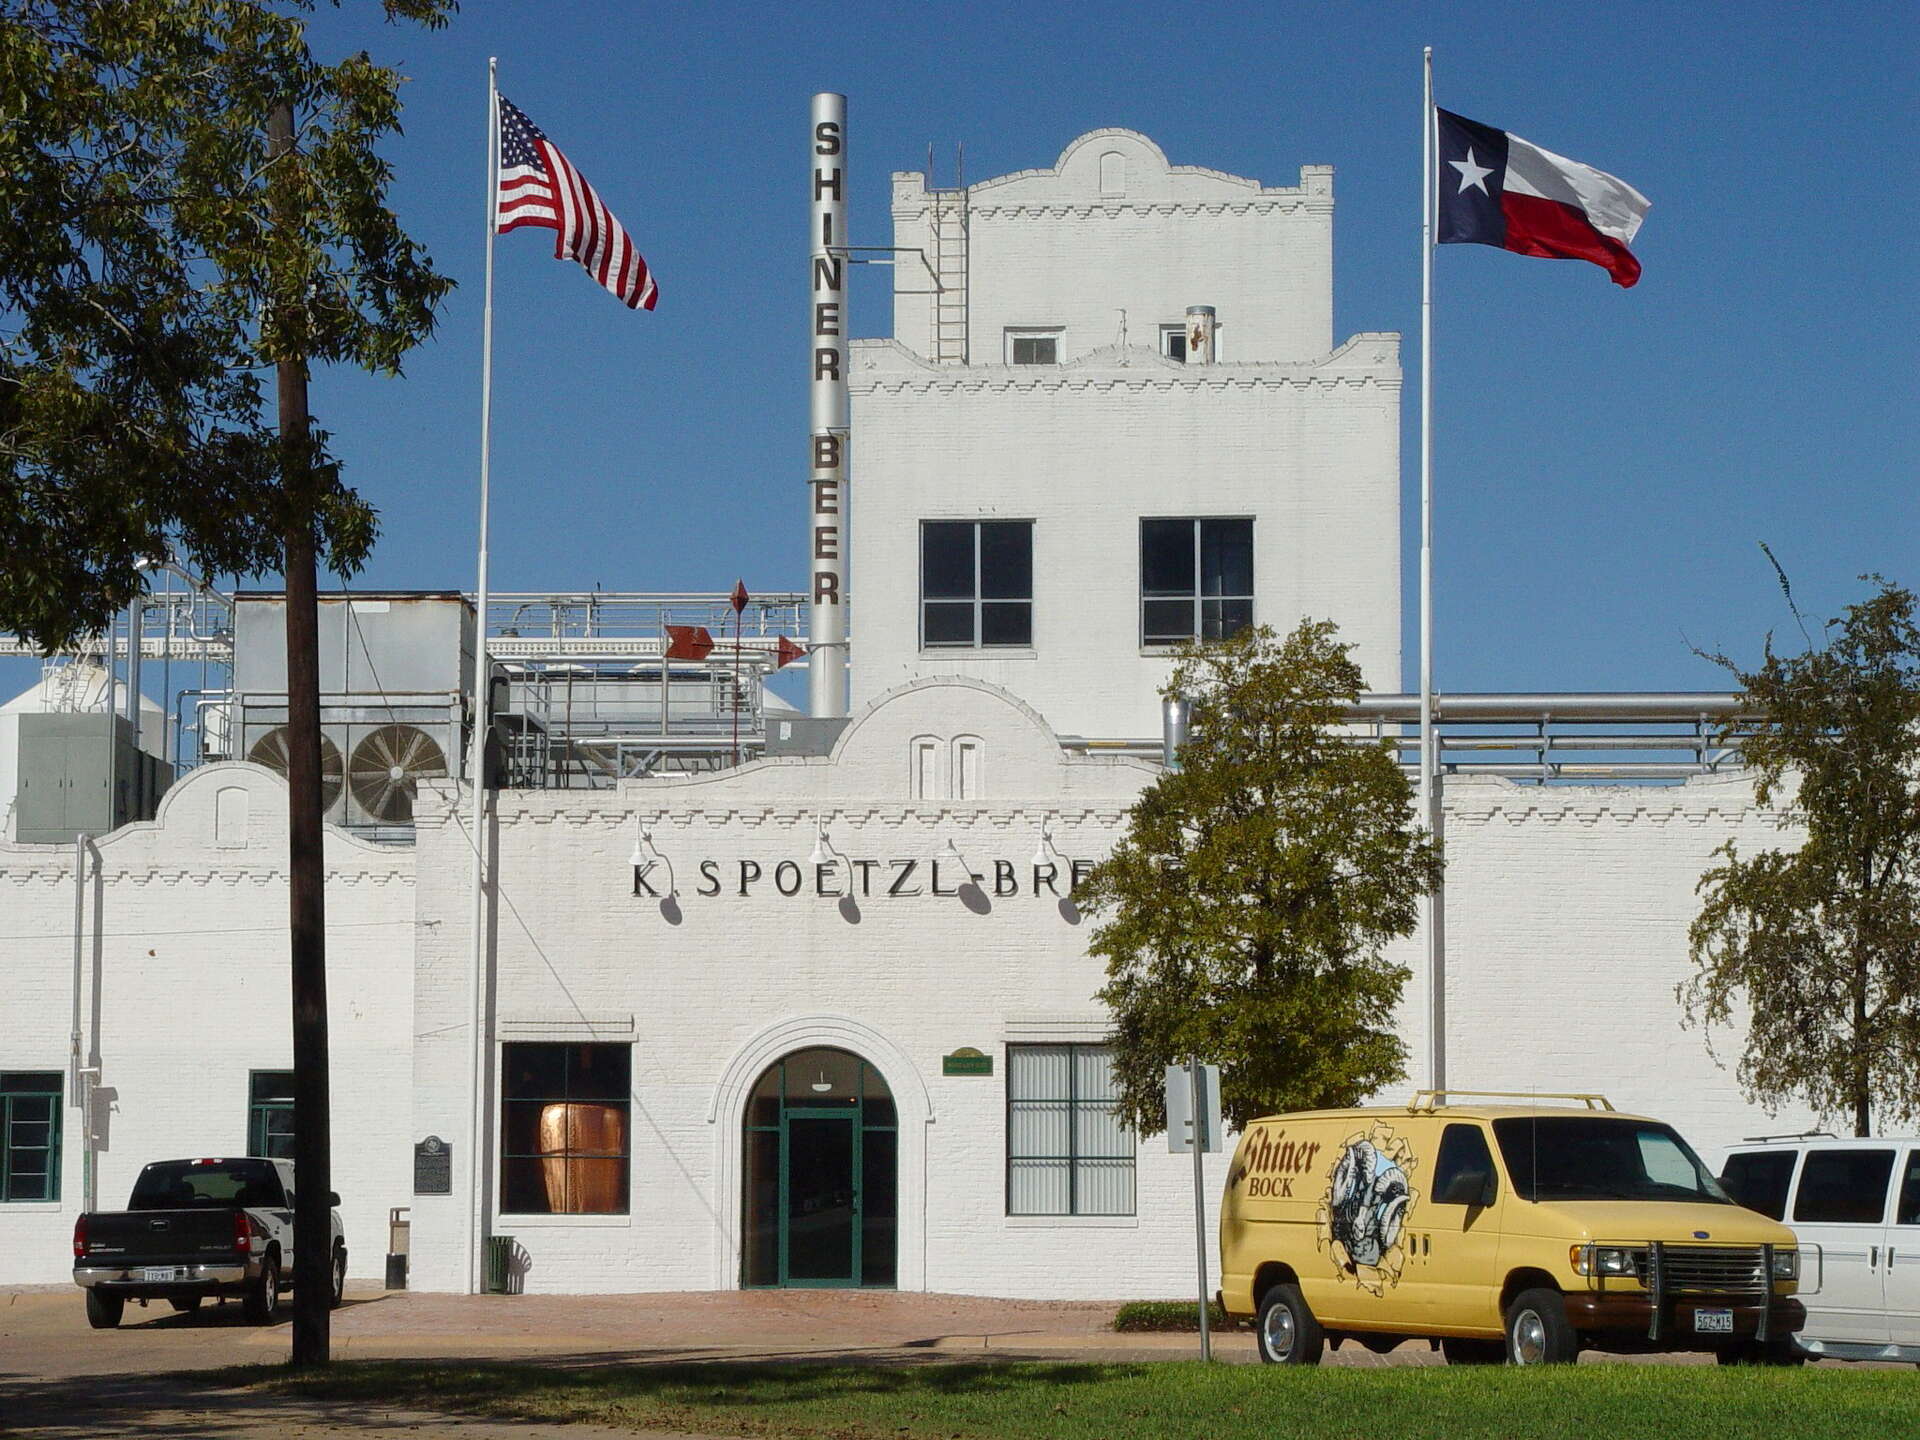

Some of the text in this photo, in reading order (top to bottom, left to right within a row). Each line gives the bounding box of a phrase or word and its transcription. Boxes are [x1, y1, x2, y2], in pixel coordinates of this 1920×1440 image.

[814, 121, 841, 606] SHINER BEER
[1238, 1126, 1321, 1181] Shiner
[1248, 1177, 1295, 1198] BOCK
